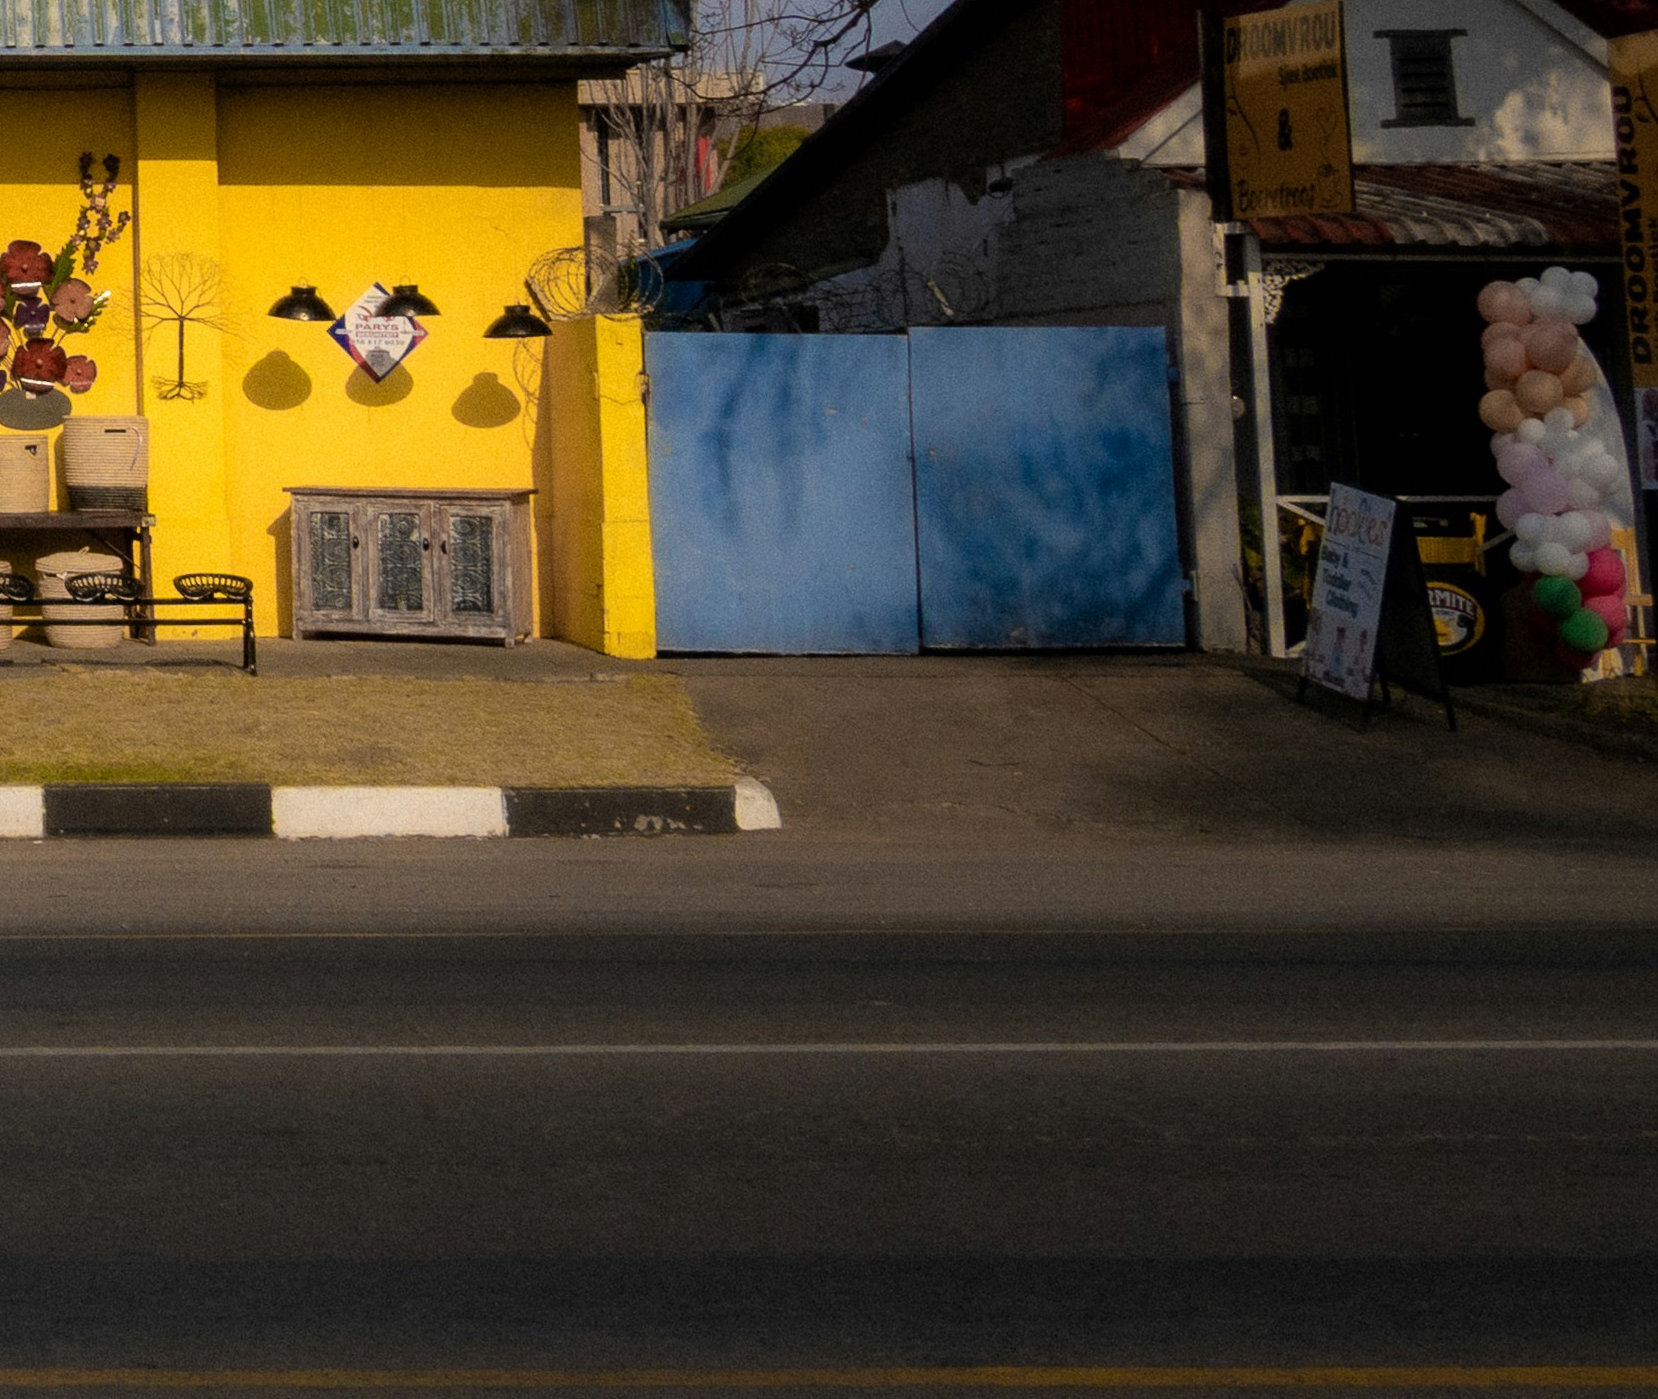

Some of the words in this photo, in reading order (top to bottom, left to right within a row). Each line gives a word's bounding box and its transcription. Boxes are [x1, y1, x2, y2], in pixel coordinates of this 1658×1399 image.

[1226, 11, 1336, 65] DROOMVROU
[1610, 84, 1653, 365] DROOMVROU
[355, 323, 399, 331] PARYS
[1427, 588, 1475, 615] RMITE
